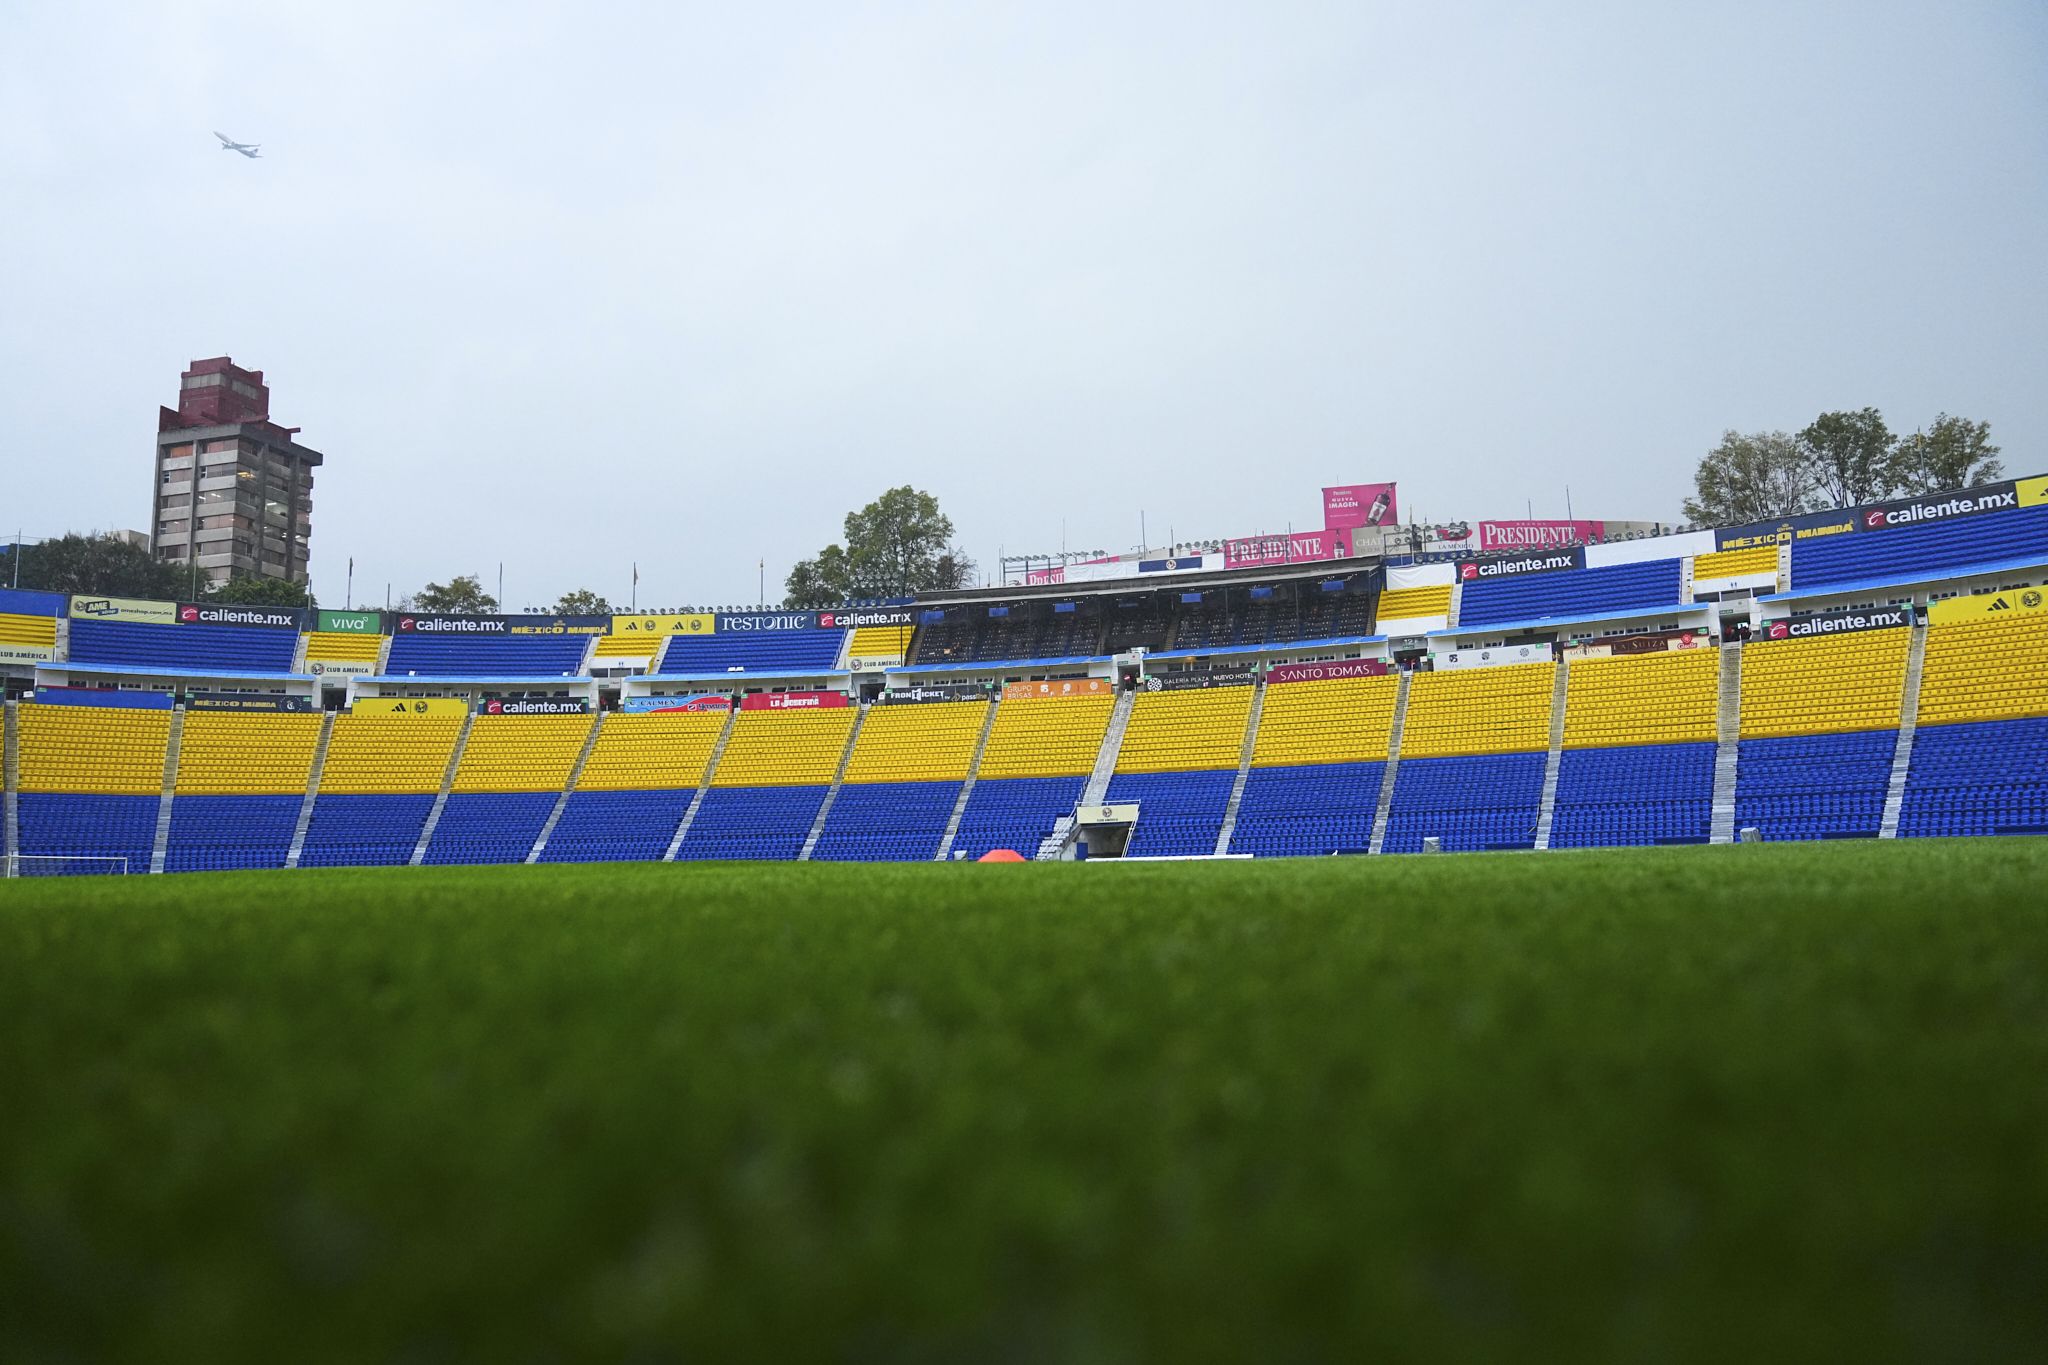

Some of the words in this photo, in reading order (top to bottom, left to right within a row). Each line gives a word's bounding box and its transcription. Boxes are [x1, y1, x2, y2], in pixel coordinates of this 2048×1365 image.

[1328, 501, 1359, 509] IMAGEN
[1886, 491, 2016, 524] caliente.mx
[1484, 523, 1577, 545] PRESIDENTE
[1722, 531, 1792, 549] MÉXICO
[1478, 554, 1573, 577] caliente.mx
[88, 601, 108, 611] AME
[120, 608, 173, 616] ameshop.com.mx
[199, 608, 292, 626] caliente.mx
[834, 612, 912, 626] caliente.mx
[1788, 609, 1903, 636] caliente.mx
[415, 618, 505, 632] caliente.mx
[511, 625, 564, 634] MÉXICO
[15, 650, 48, 660] AMÉRICA
[877, 659, 901, 667] AMÉRICA
[342, 666, 369, 674] AMÉRICA
[1280, 668, 1323, 681] SANTO
[1163, 677, 1189, 685] GALERÍA
[1213, 673, 1234, 681] NUEVO
[1235, 672, 1254, 680] HOTEL
[1007, 684, 1033, 692] GRUPO
[502, 700, 582, 713] caliente.mx
